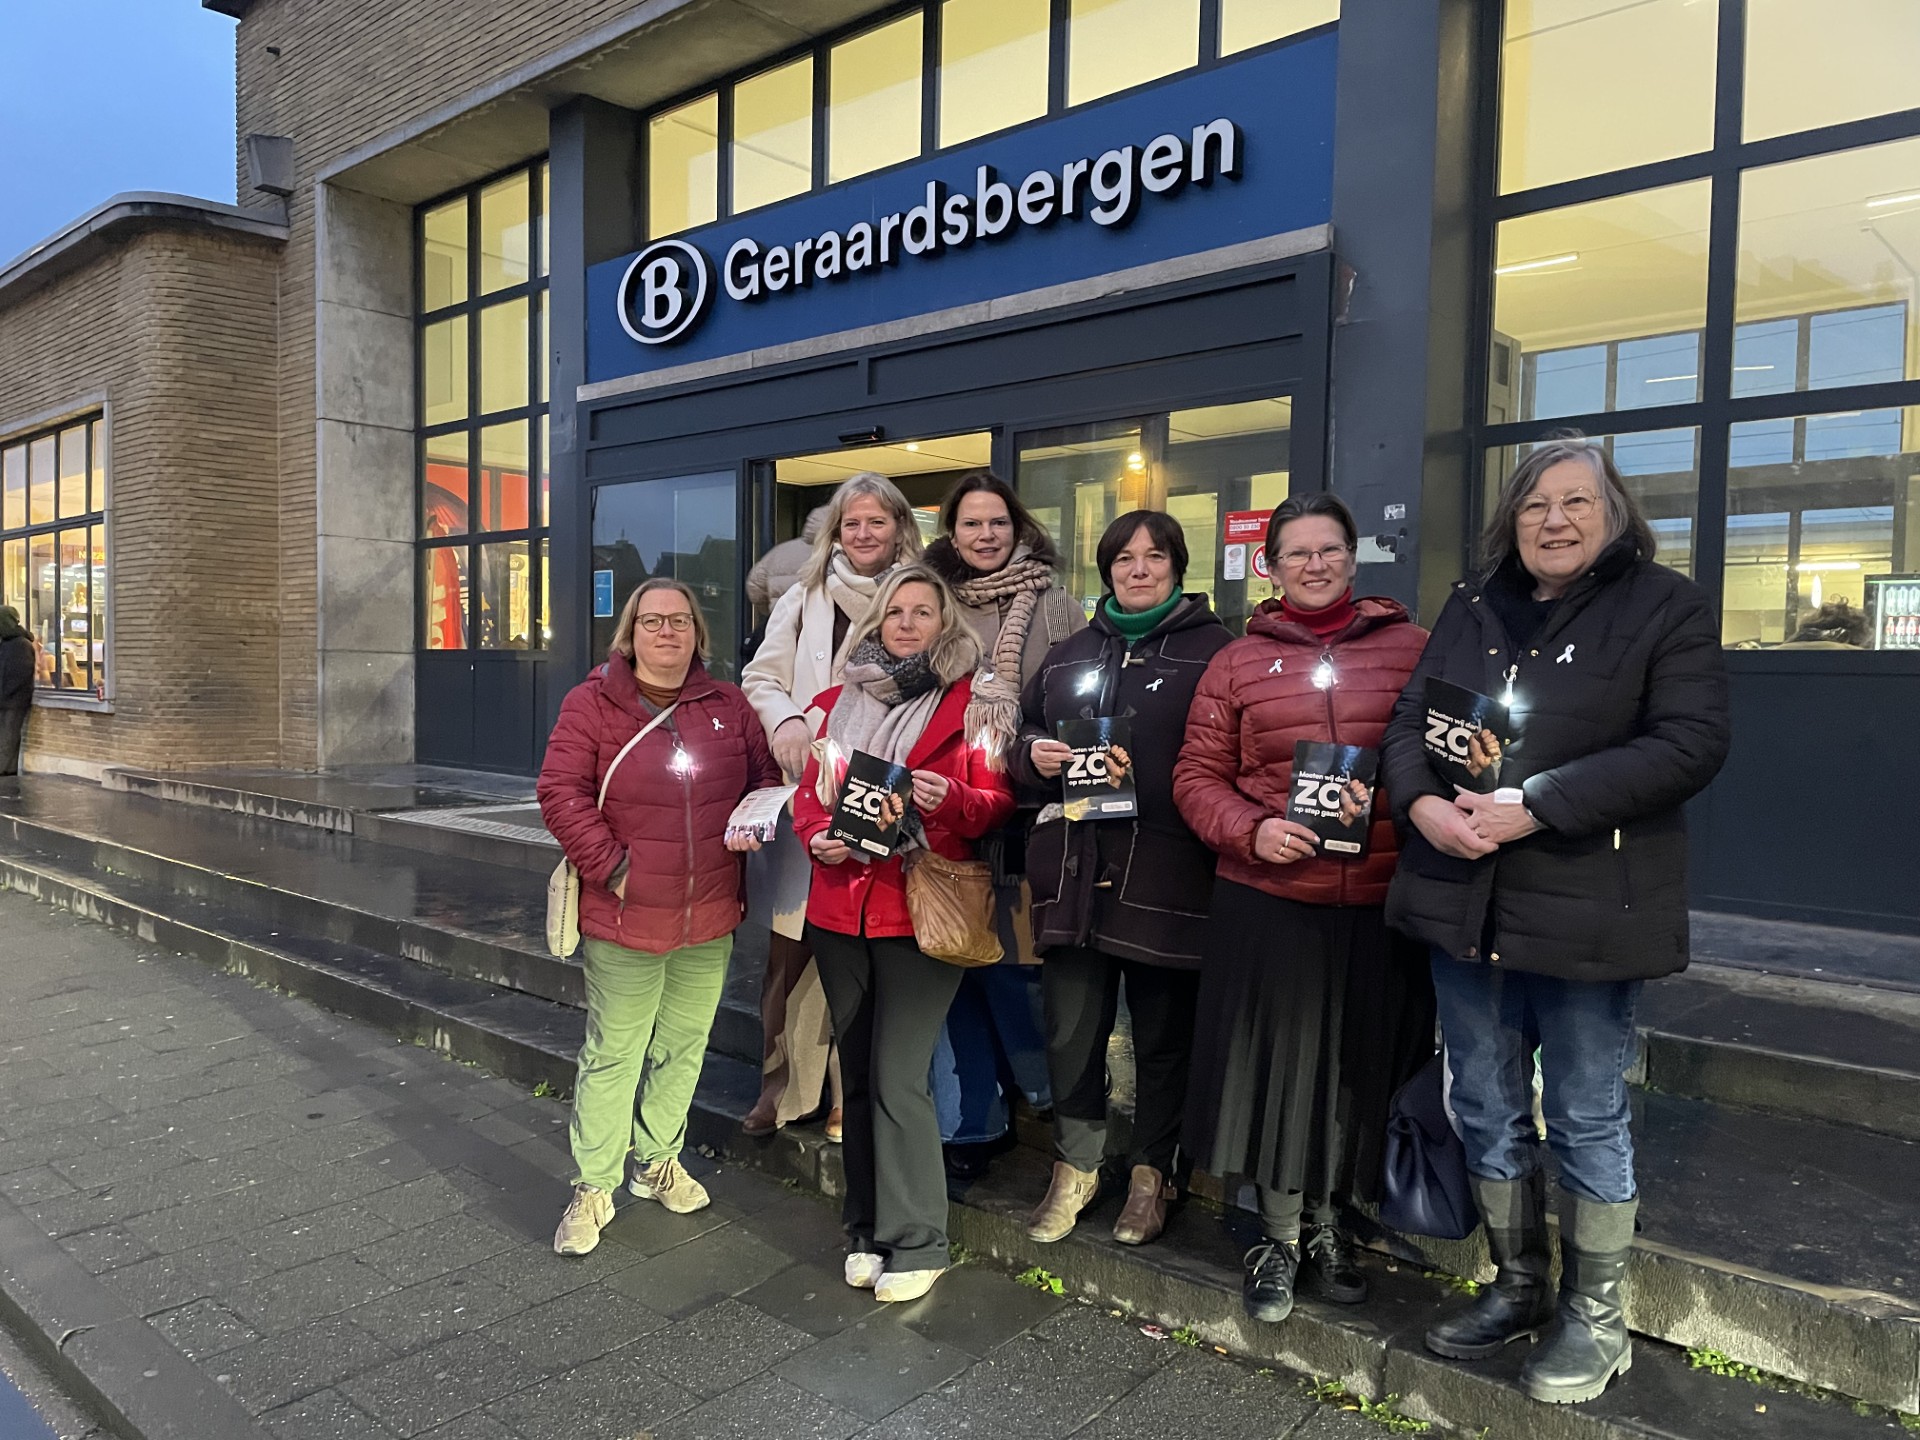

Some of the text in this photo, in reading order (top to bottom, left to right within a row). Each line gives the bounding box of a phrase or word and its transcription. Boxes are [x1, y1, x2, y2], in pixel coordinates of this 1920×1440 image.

[724, 117, 1235, 300] Geraardsbergen
[1428, 708, 1453, 722] Moeten
[1454, 718, 1465, 728] wij
[1448, 754, 1471, 766] gaan?
[1092, 776, 1111, 785] gaan?
[1299, 771, 1323, 780] Moeten
[1304, 807, 1320, 816] stap
[1321, 810, 1343, 818] gaan?
